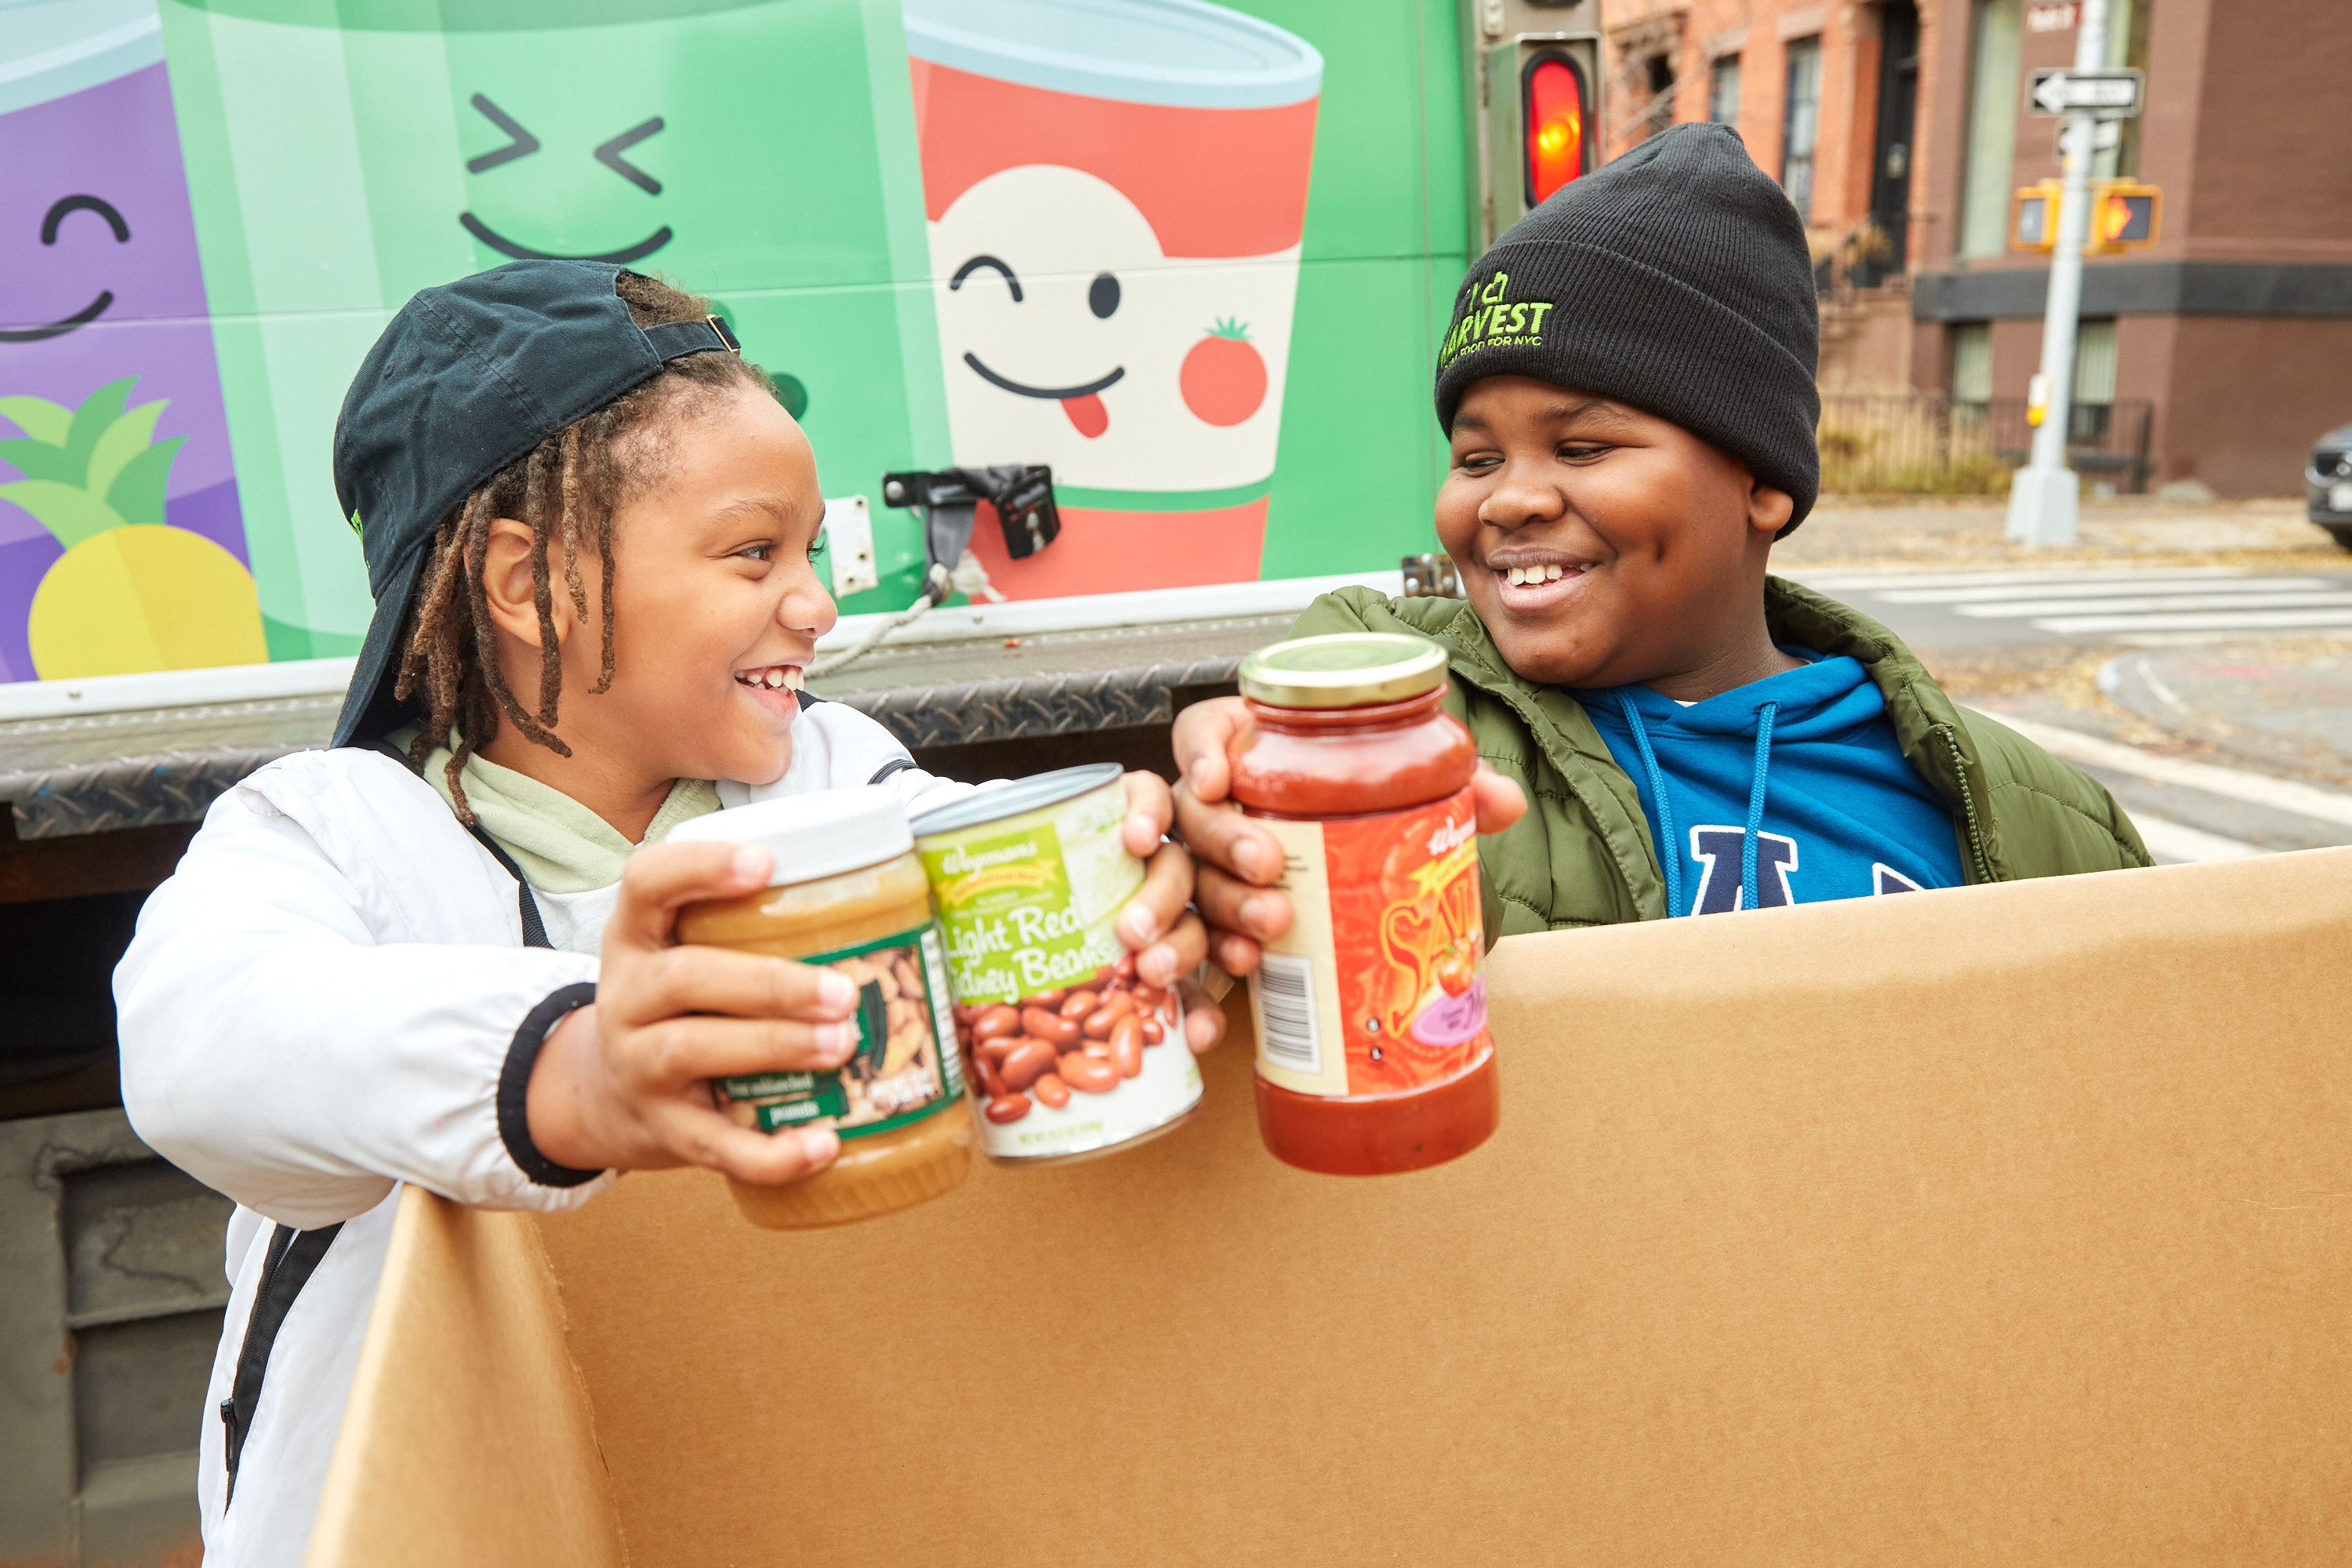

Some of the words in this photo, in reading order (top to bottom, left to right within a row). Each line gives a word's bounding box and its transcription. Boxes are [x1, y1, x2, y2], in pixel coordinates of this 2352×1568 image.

[1487, 336, 1512, 347] FOR
[1514, 336, 1542, 346] NYC
[1007, 895, 1083, 946] Red
[1011, 942, 1112, 988] Beans
